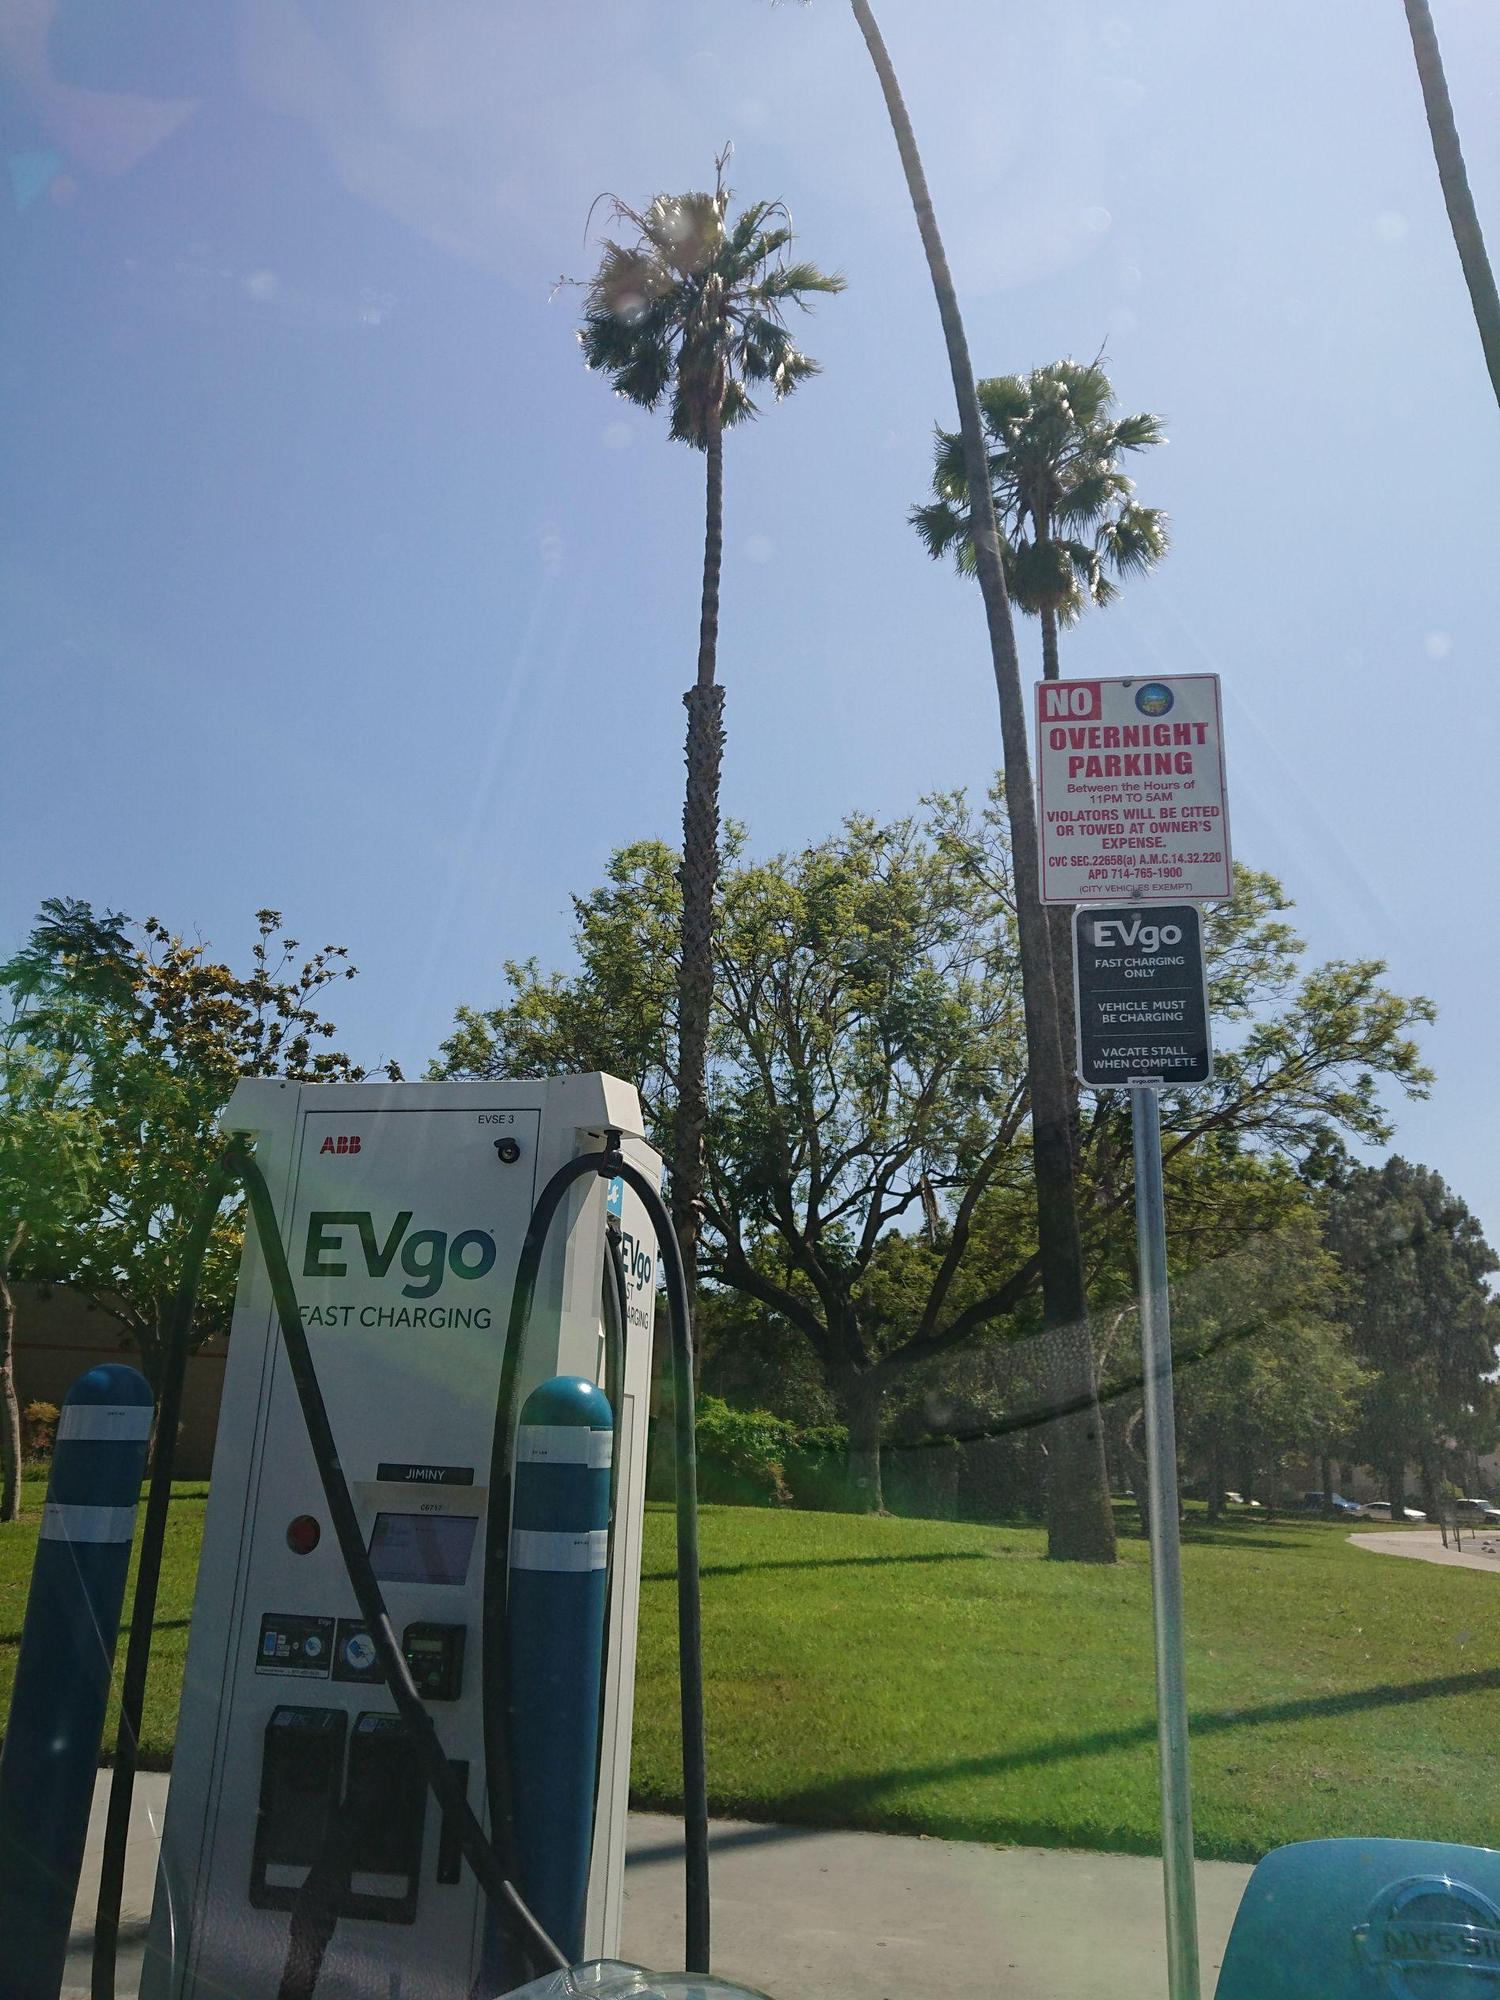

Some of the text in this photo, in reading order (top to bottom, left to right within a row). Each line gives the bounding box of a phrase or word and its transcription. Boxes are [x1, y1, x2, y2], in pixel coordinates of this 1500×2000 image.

[1046, 687, 1093, 717] NO
[1049, 723, 1208, 750] OVERNIGHT
[1068, 752, 1193, 778] PARKING
[1067, 780, 1195, 793] Between the Hours of
[1090, 792, 1173, 804] 11PM TO 5AM
[1047, 806, 1220, 822] VIOLATORS WILL BE CITED
[1056, 821, 1212, 836] OR TOWED AT OWNER'S
[1102, 836, 1167, 849] EXPENSE.
[1049, 856, 1067, 867] CVC
[1088, 867, 1182, 880] APD 714-765-1900
[1080, 883, 1193, 894] (CITY VEHICLES EXEMPT)
[1093, 920, 1182, 954] EVgo
[1095, 956, 1185, 968] FAST CHARGING
[1124, 968, 1156, 978] ONLY
[1098, 1000, 1186, 1012] VEHICLE MUST
[1102, 1012, 1183, 1023] BE CHARGING
[1102, 1046, 1188, 1057] VACATE STALL
[1093, 1057, 1198, 1069] WHEN COMPLETE
[478, 1115, 514, 1124] EVSE 3
[320, 1136, 361, 1154] ABB
[302, 1211, 496, 1299] EVgo
[621, 1231, 651, 1291] EVgo
[359, 1306, 491, 1330] CHARGING
[406, 1468, 446, 1480] JIMINY
